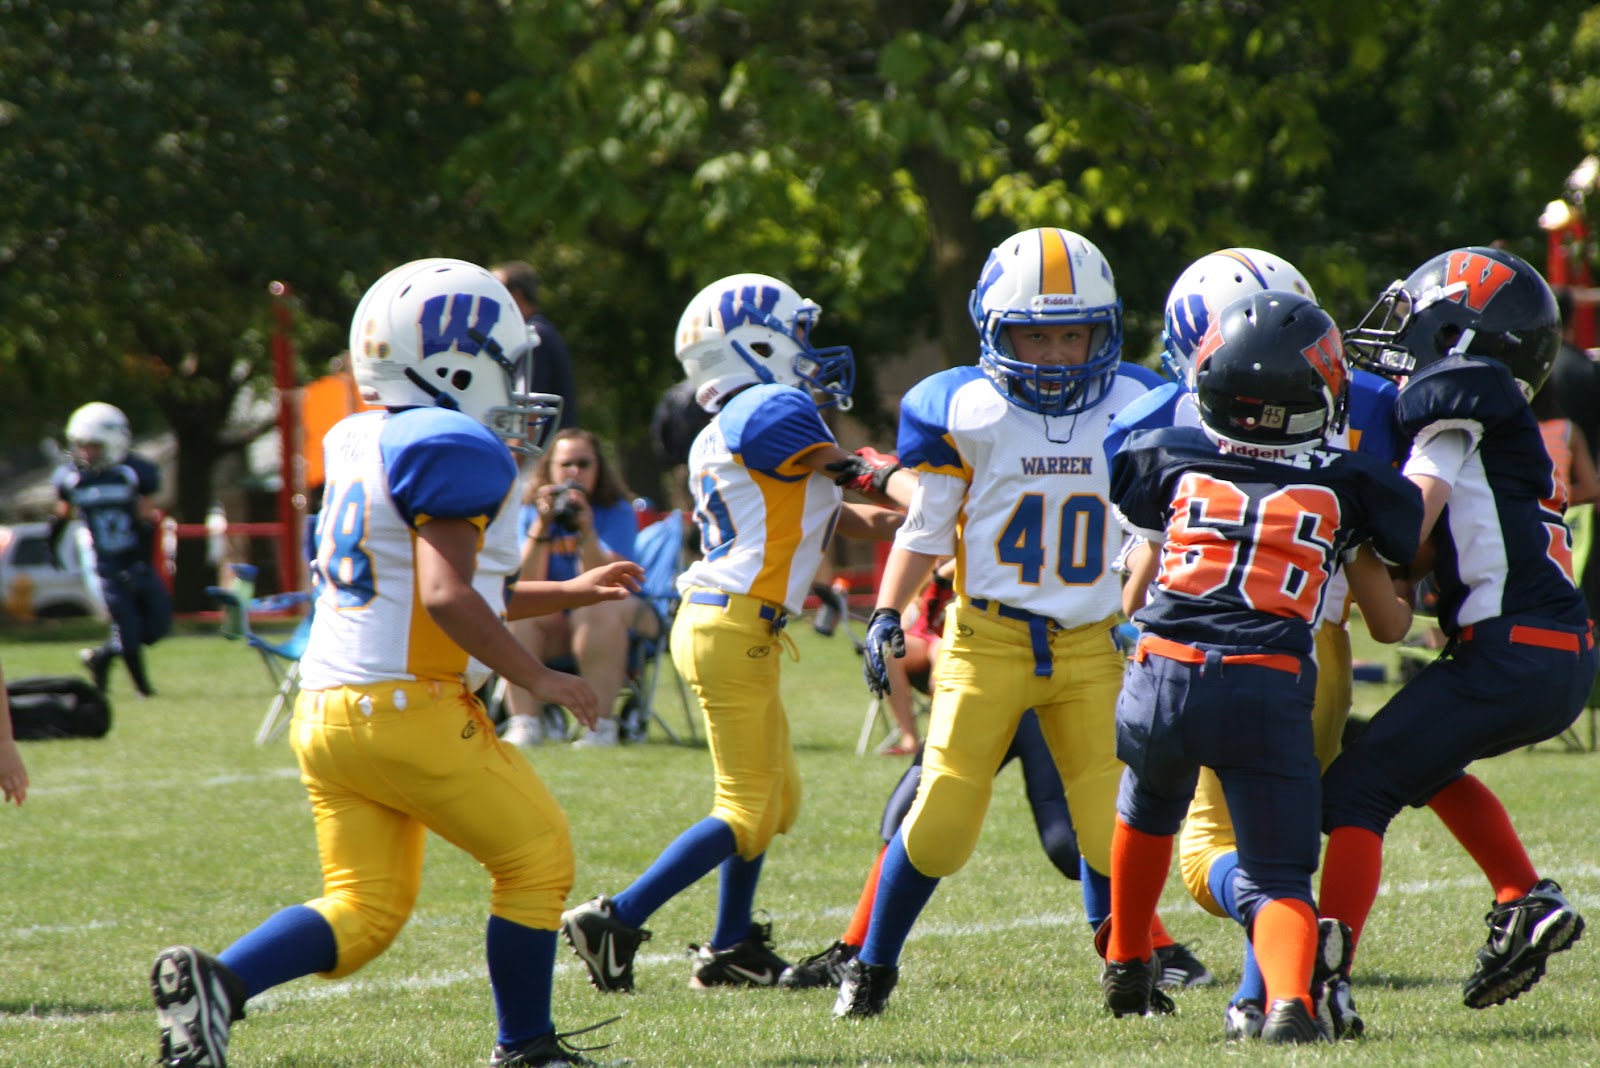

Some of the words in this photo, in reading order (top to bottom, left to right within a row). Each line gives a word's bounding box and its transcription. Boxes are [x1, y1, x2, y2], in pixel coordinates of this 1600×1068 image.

[1446, 251, 1516, 314] W
[718, 285, 780, 334] W
[1043, 297, 1074, 305] Riddell
[418, 293, 501, 361] W
[1264, 407, 1281, 424] 45
[1021, 457, 1092, 475] WARREN
[1218, 439, 1287, 459] Riddell
[994, 492, 1108, 586] 40
